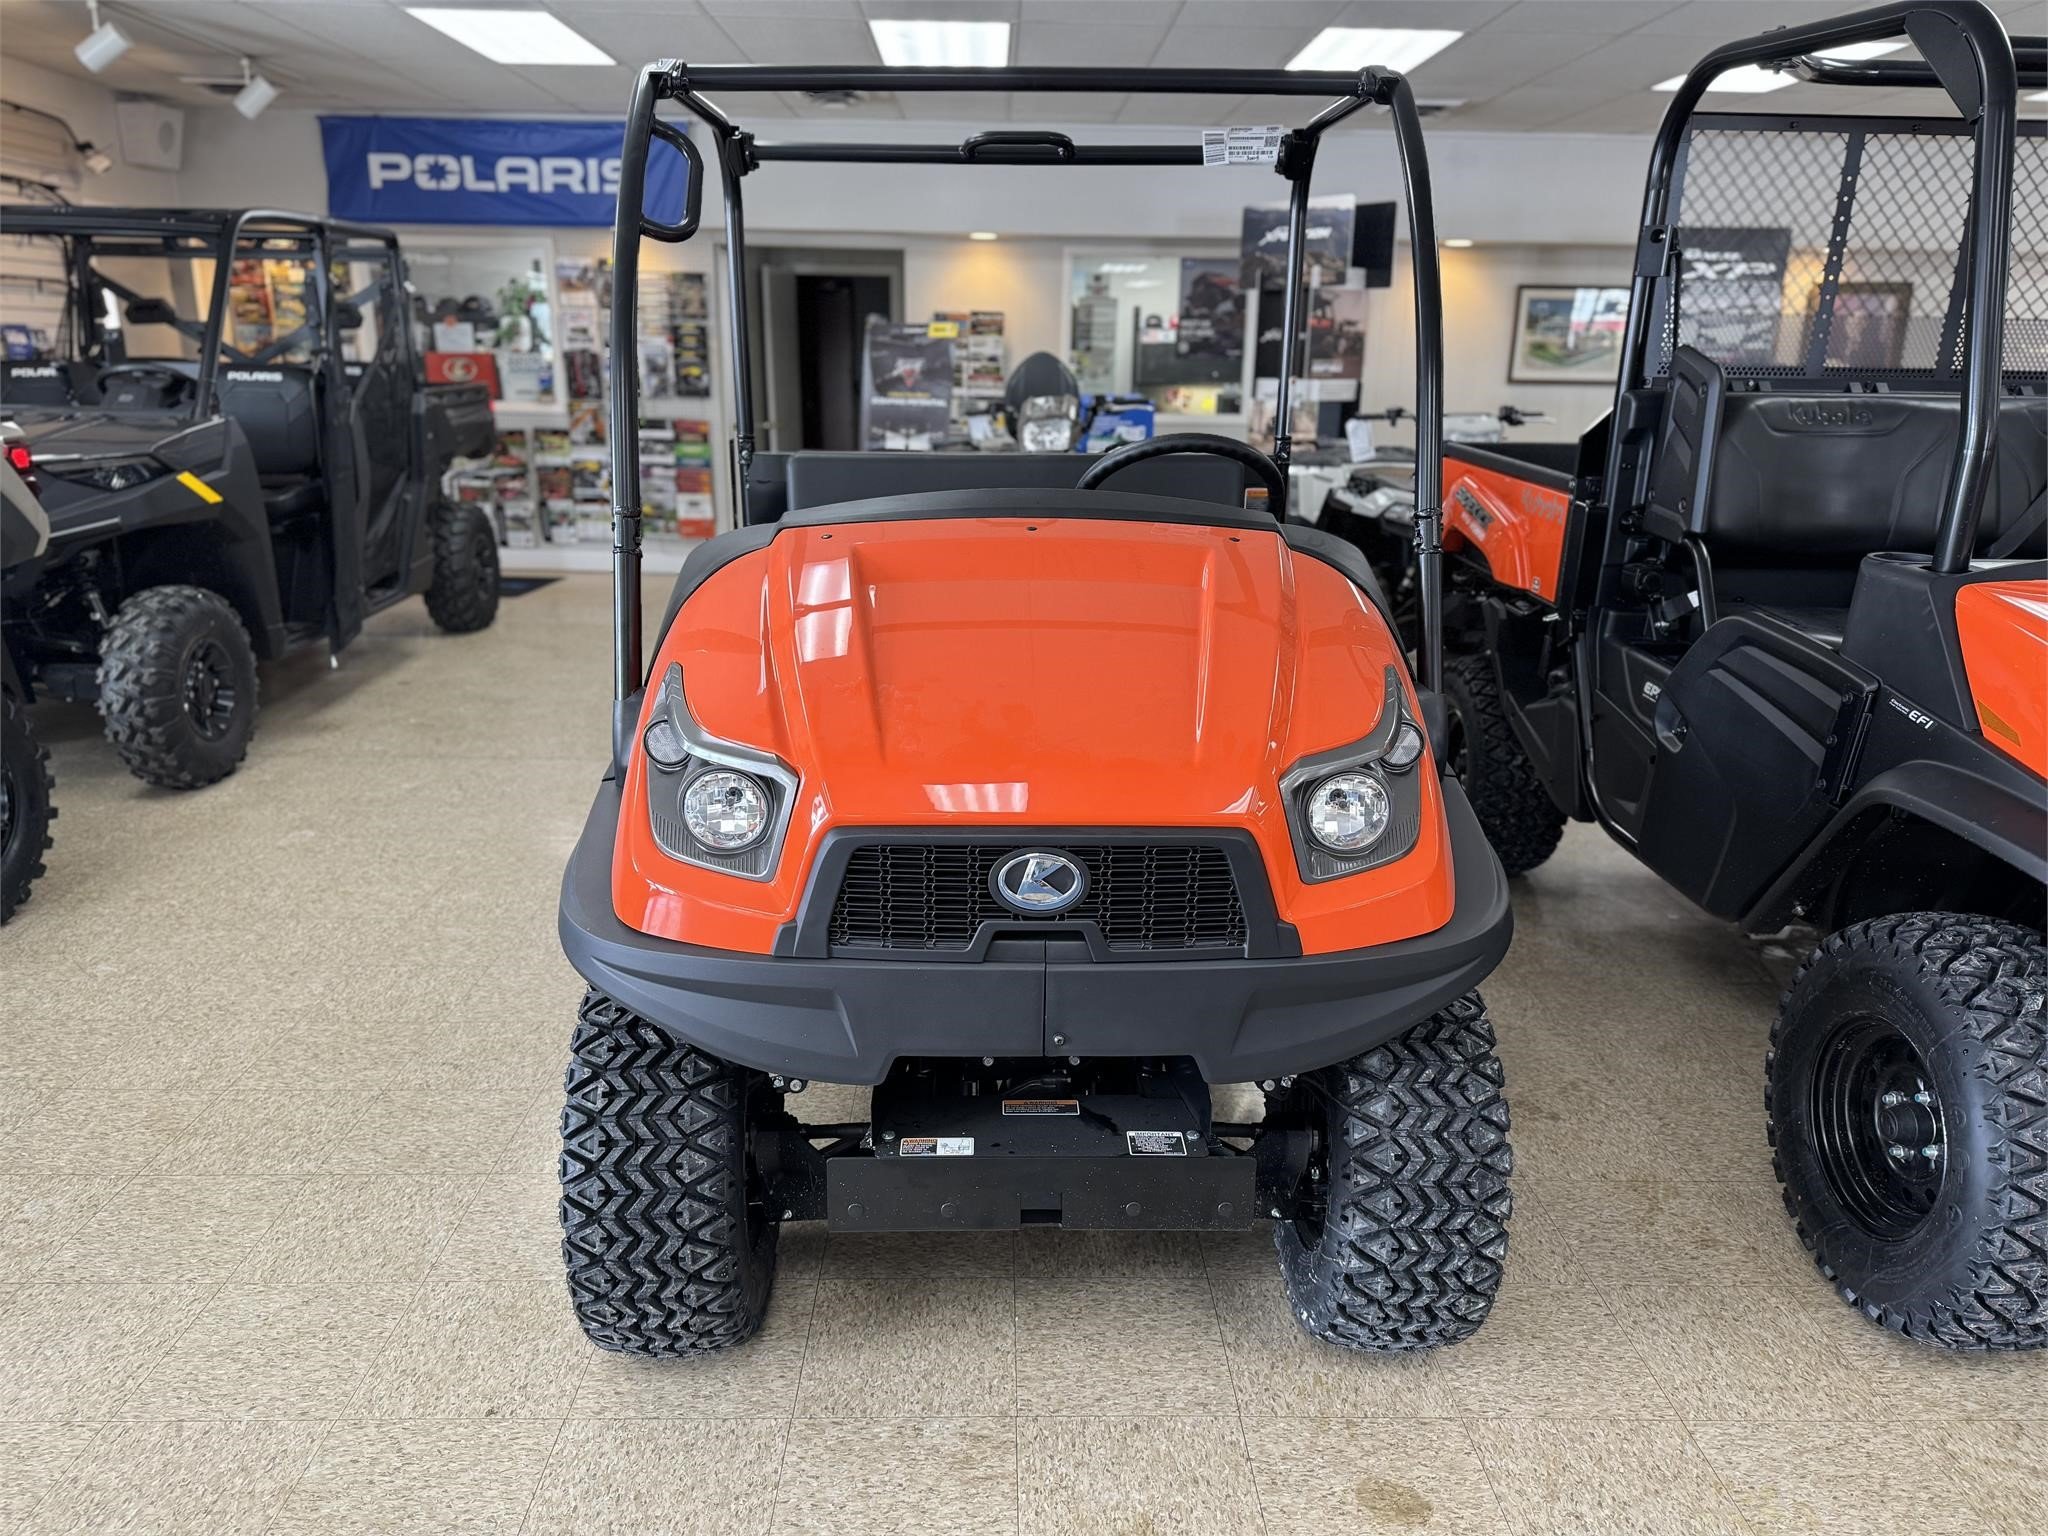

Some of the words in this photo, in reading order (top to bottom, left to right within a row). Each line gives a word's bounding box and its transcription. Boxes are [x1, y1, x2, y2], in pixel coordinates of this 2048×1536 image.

[366, 151, 623, 194] POLARIS
[11, 367, 58, 379] POLAR
[227, 370, 283, 382] POLARIS
[1643, 681, 1662, 700] EP
[1908, 709, 1934, 729] EFI
